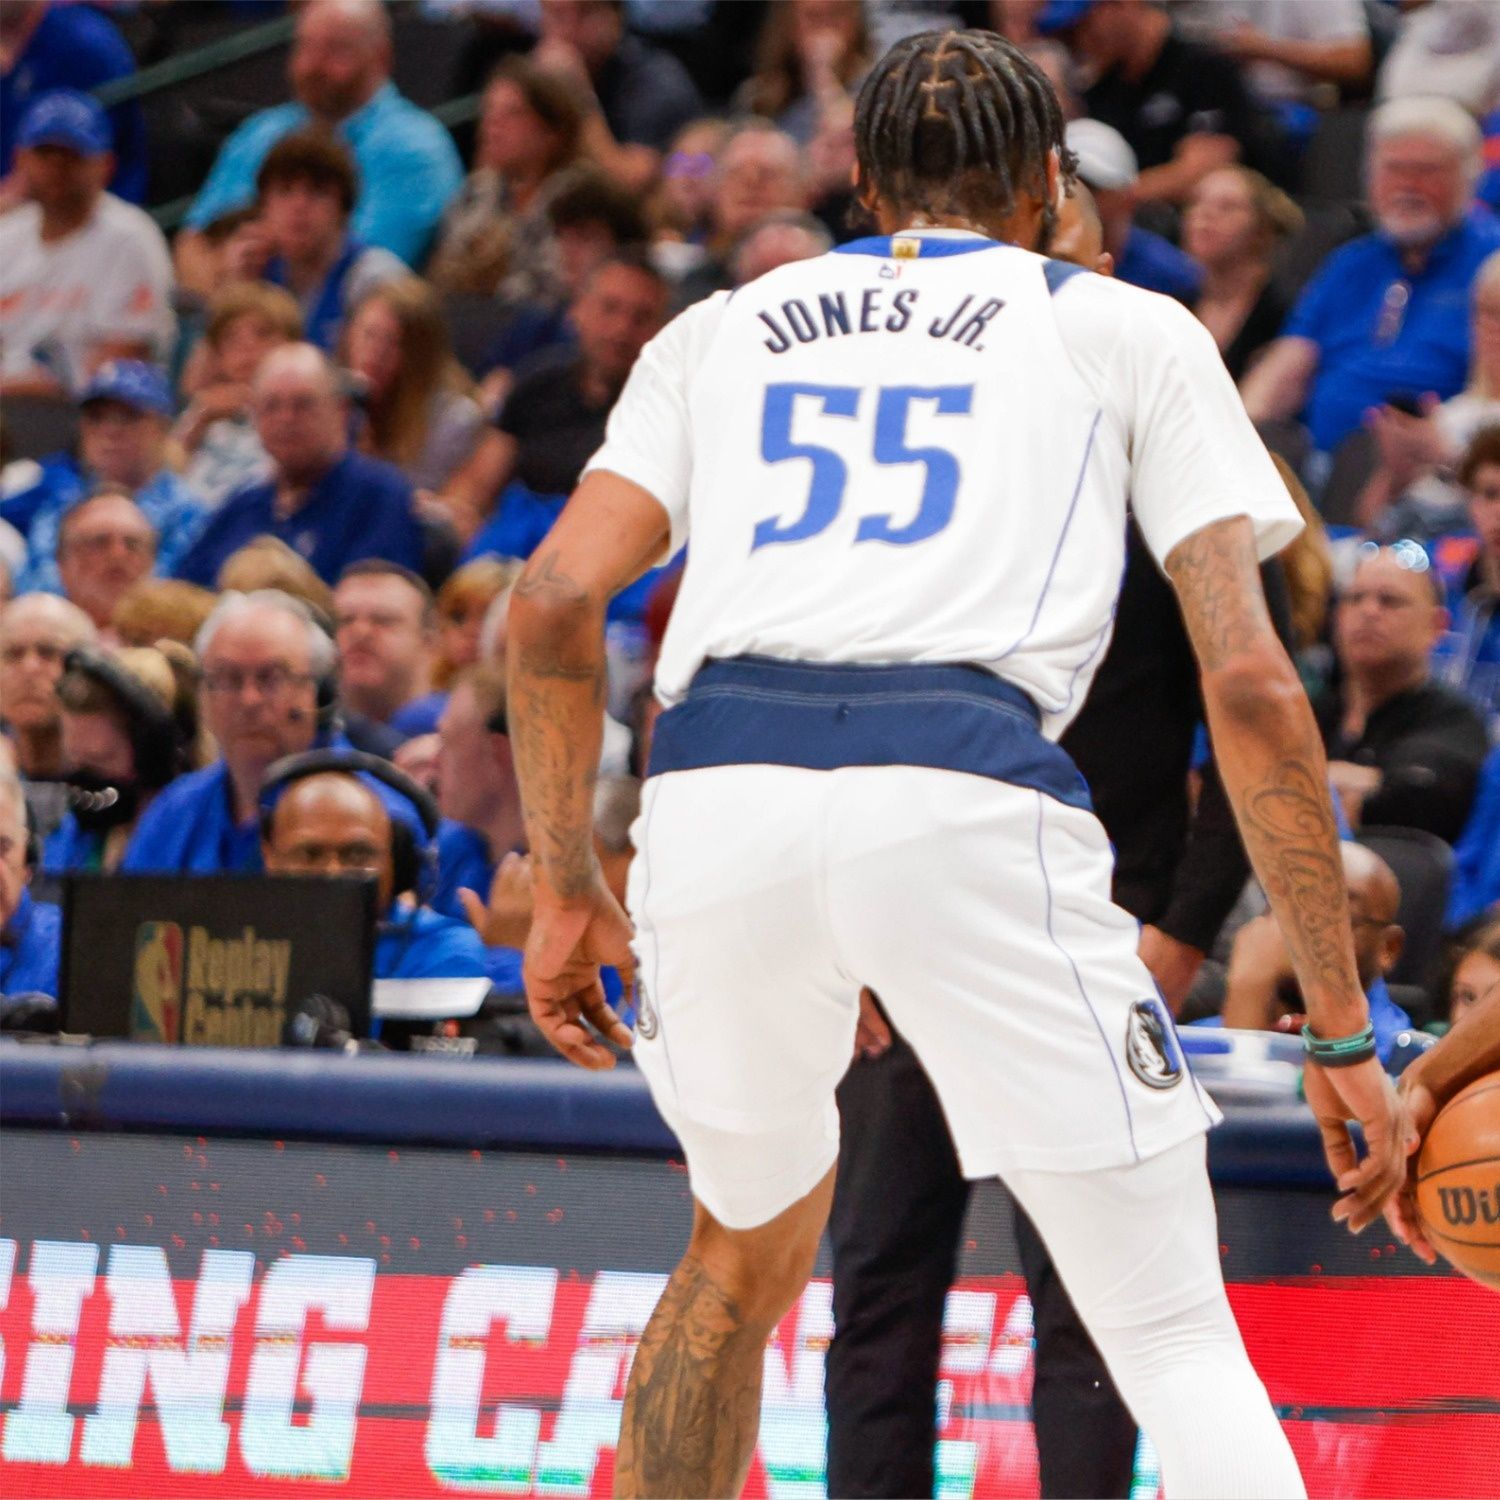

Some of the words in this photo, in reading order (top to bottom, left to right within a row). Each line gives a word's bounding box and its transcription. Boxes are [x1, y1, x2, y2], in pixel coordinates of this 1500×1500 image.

[757, 287, 919, 354] JONES
[927, 293, 1007, 352] JR.
[749, 381, 976, 557] 55
[188, 925, 292, 1005] Replay
[0, 1237, 378, 1484] ING
